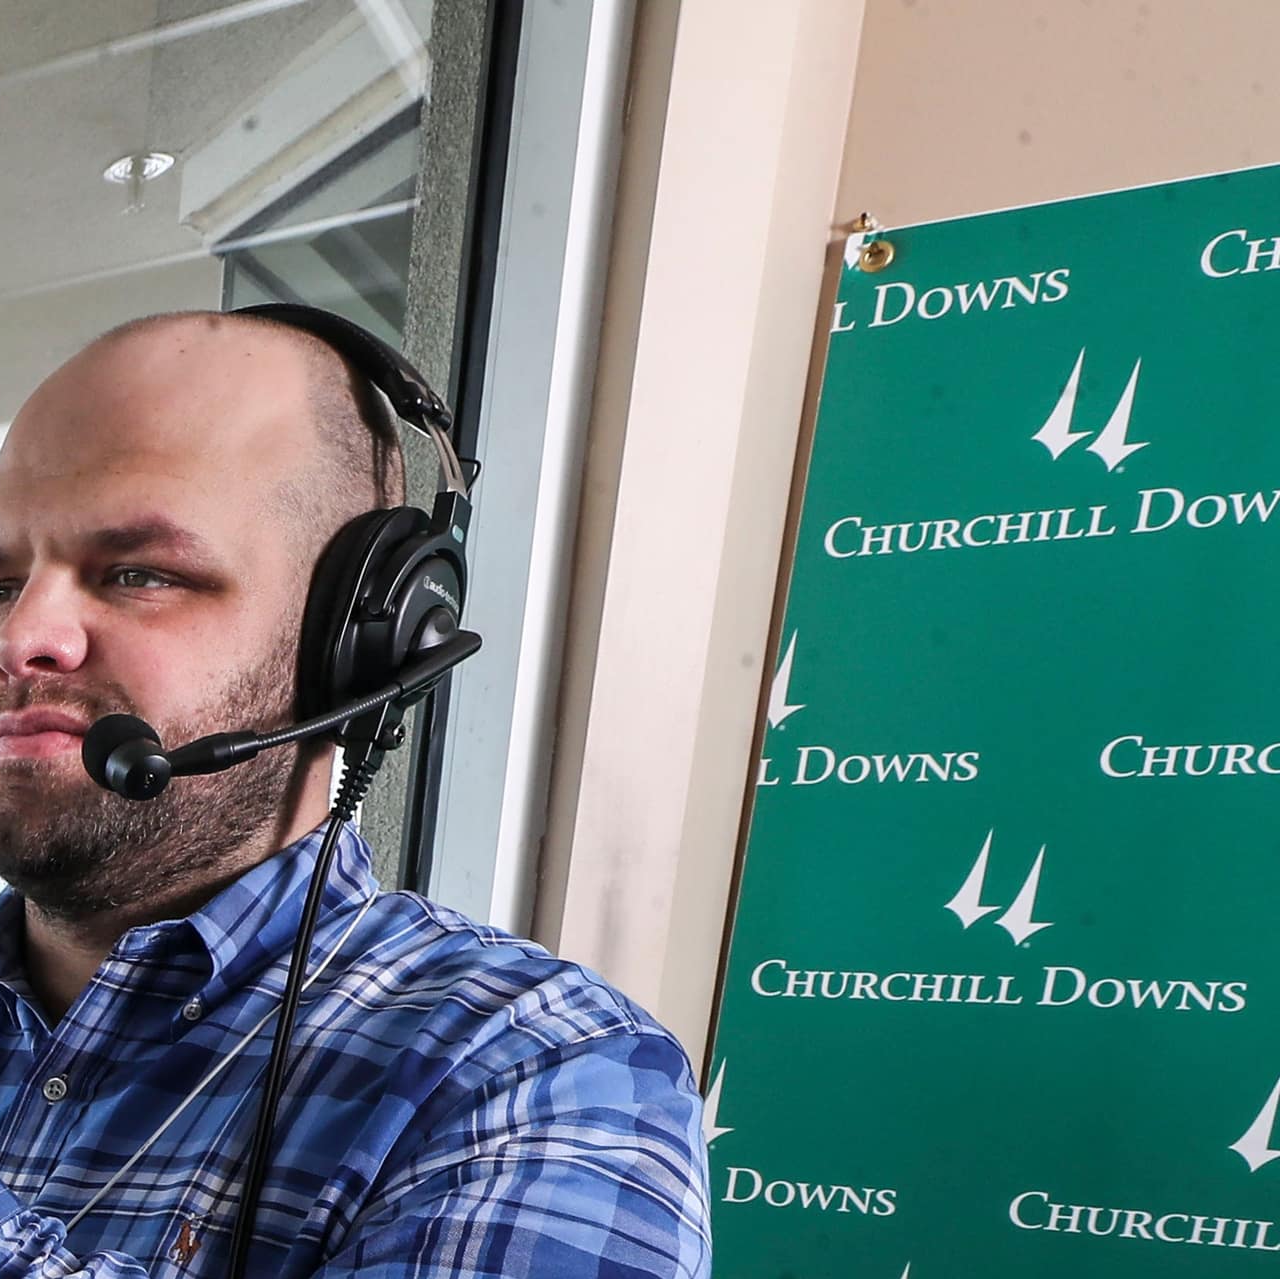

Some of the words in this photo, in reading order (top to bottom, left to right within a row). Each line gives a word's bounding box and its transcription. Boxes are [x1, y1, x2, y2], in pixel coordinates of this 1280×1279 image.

[868, 268, 1071, 329] DOWNS
[824, 506, 1116, 559] CHURCHILL
[792, 746, 980, 784] DOWNS
[751, 959, 1023, 1005] CHURCHILL
[1037, 966, 1248, 1013] DOWNS
[721, 1166, 897, 1217] DOWNS
